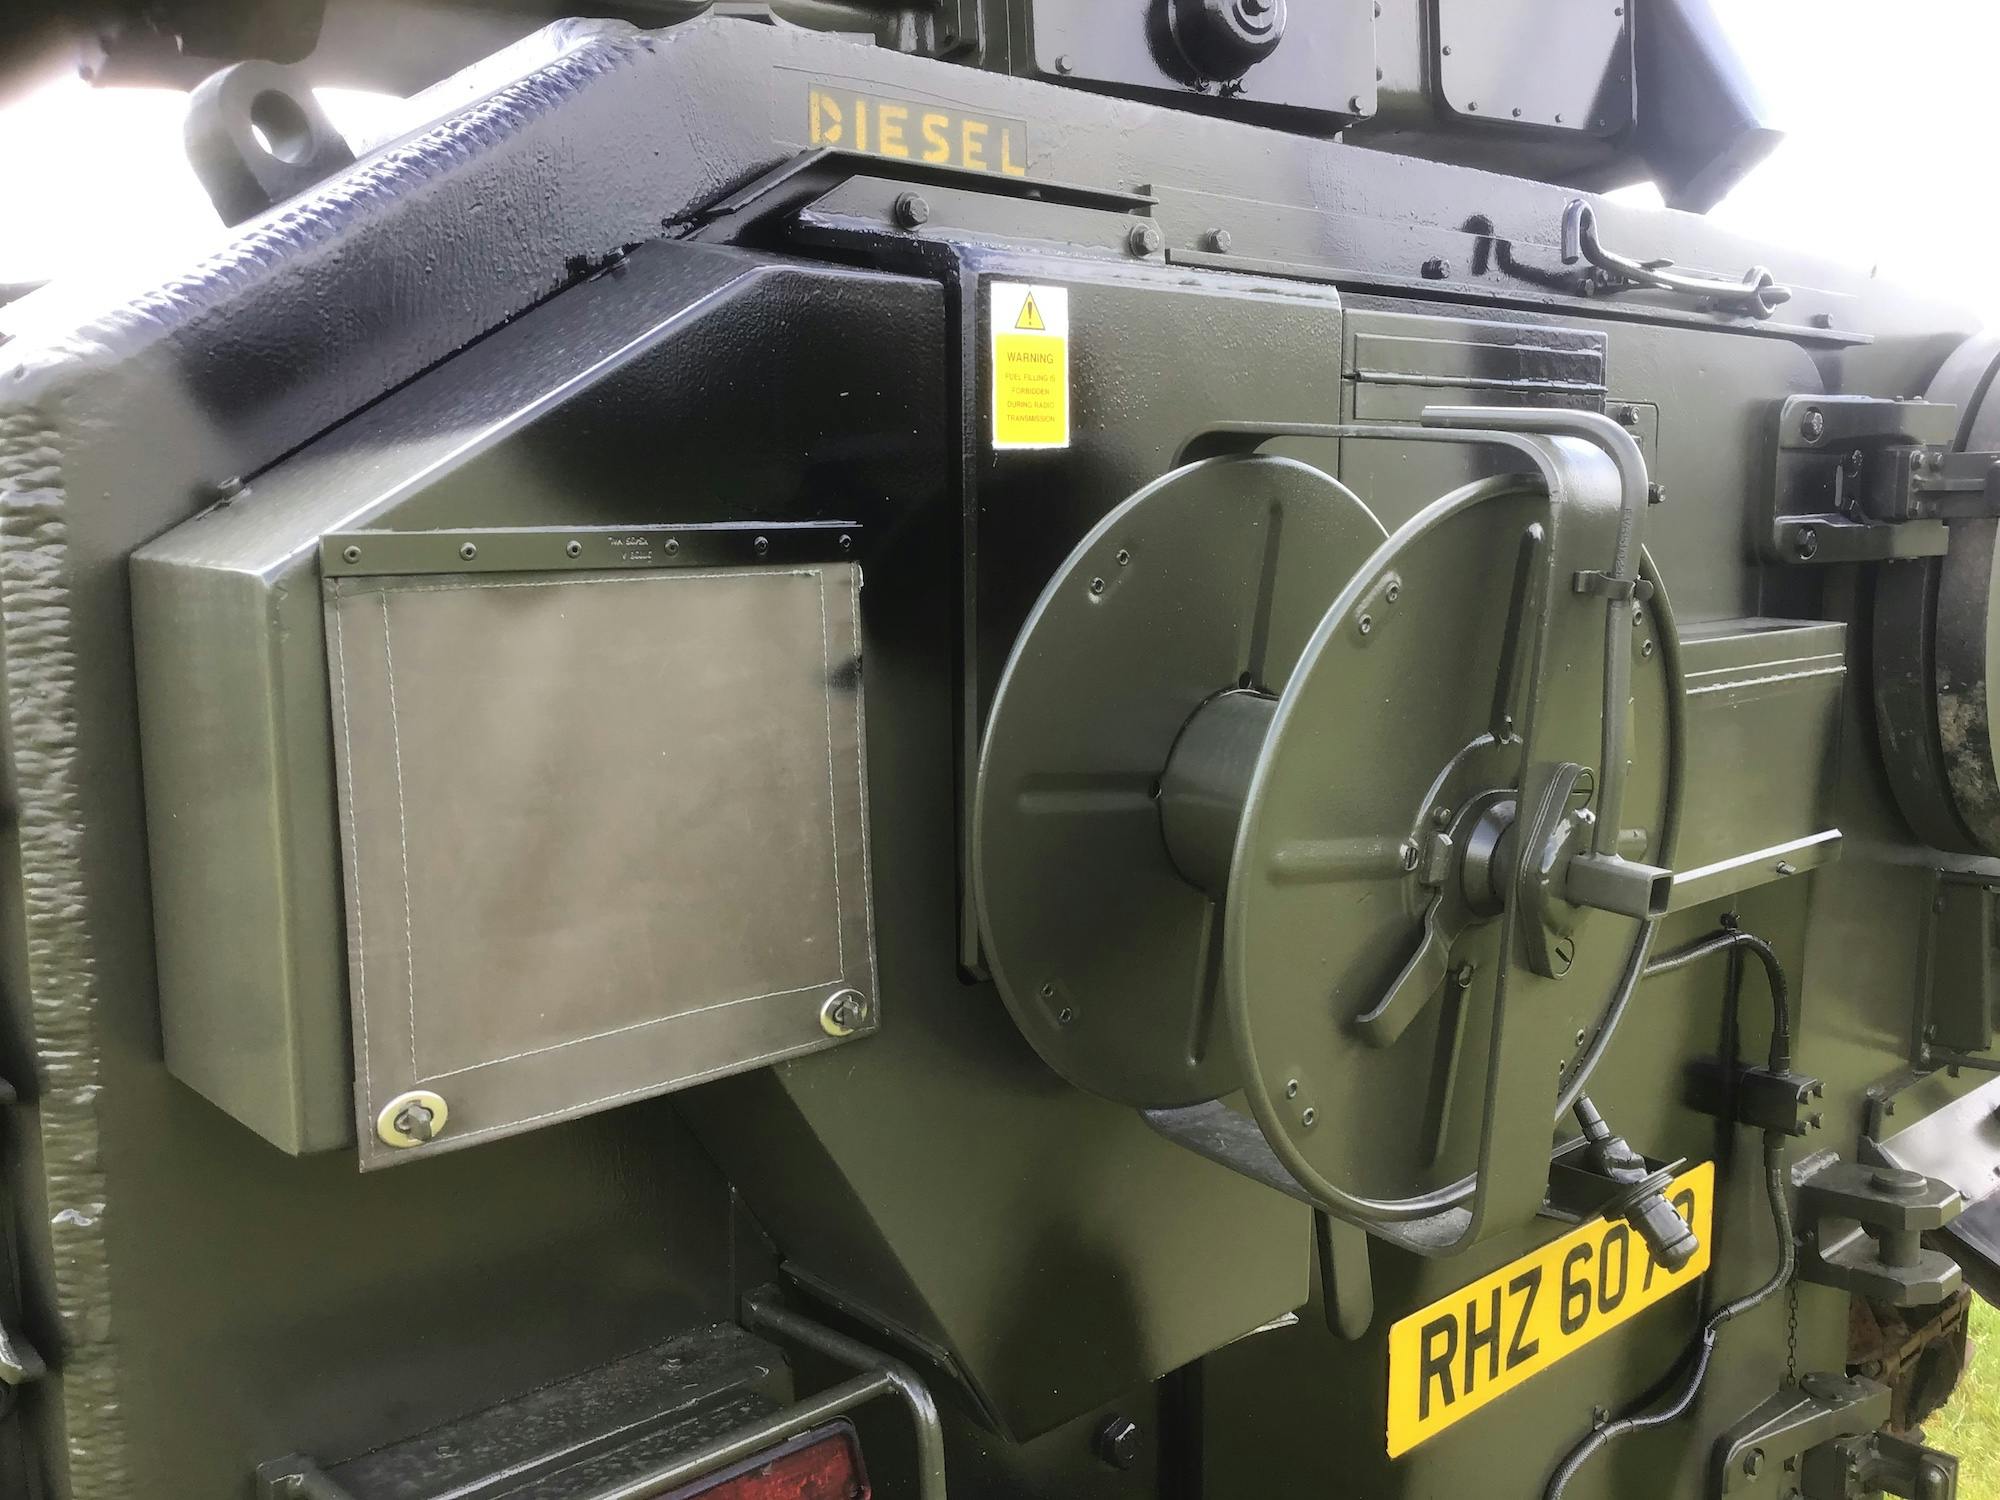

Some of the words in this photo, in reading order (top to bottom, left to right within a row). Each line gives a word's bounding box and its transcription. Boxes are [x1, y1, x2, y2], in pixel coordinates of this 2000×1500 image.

[810, 91, 1025, 176] DIESEL
[1007, 352, 1054, 364] WARNING
[1005, 373, 1021, 381] FUEL
[1023, 374, 1048, 382] FILLING
[1012, 387, 1050, 395] FORBIDDEN
[1034, 401, 1054, 409] RADIO
[1419, 1265, 1542, 1422] RHZ
[1560, 1188, 1695, 1336] 60
